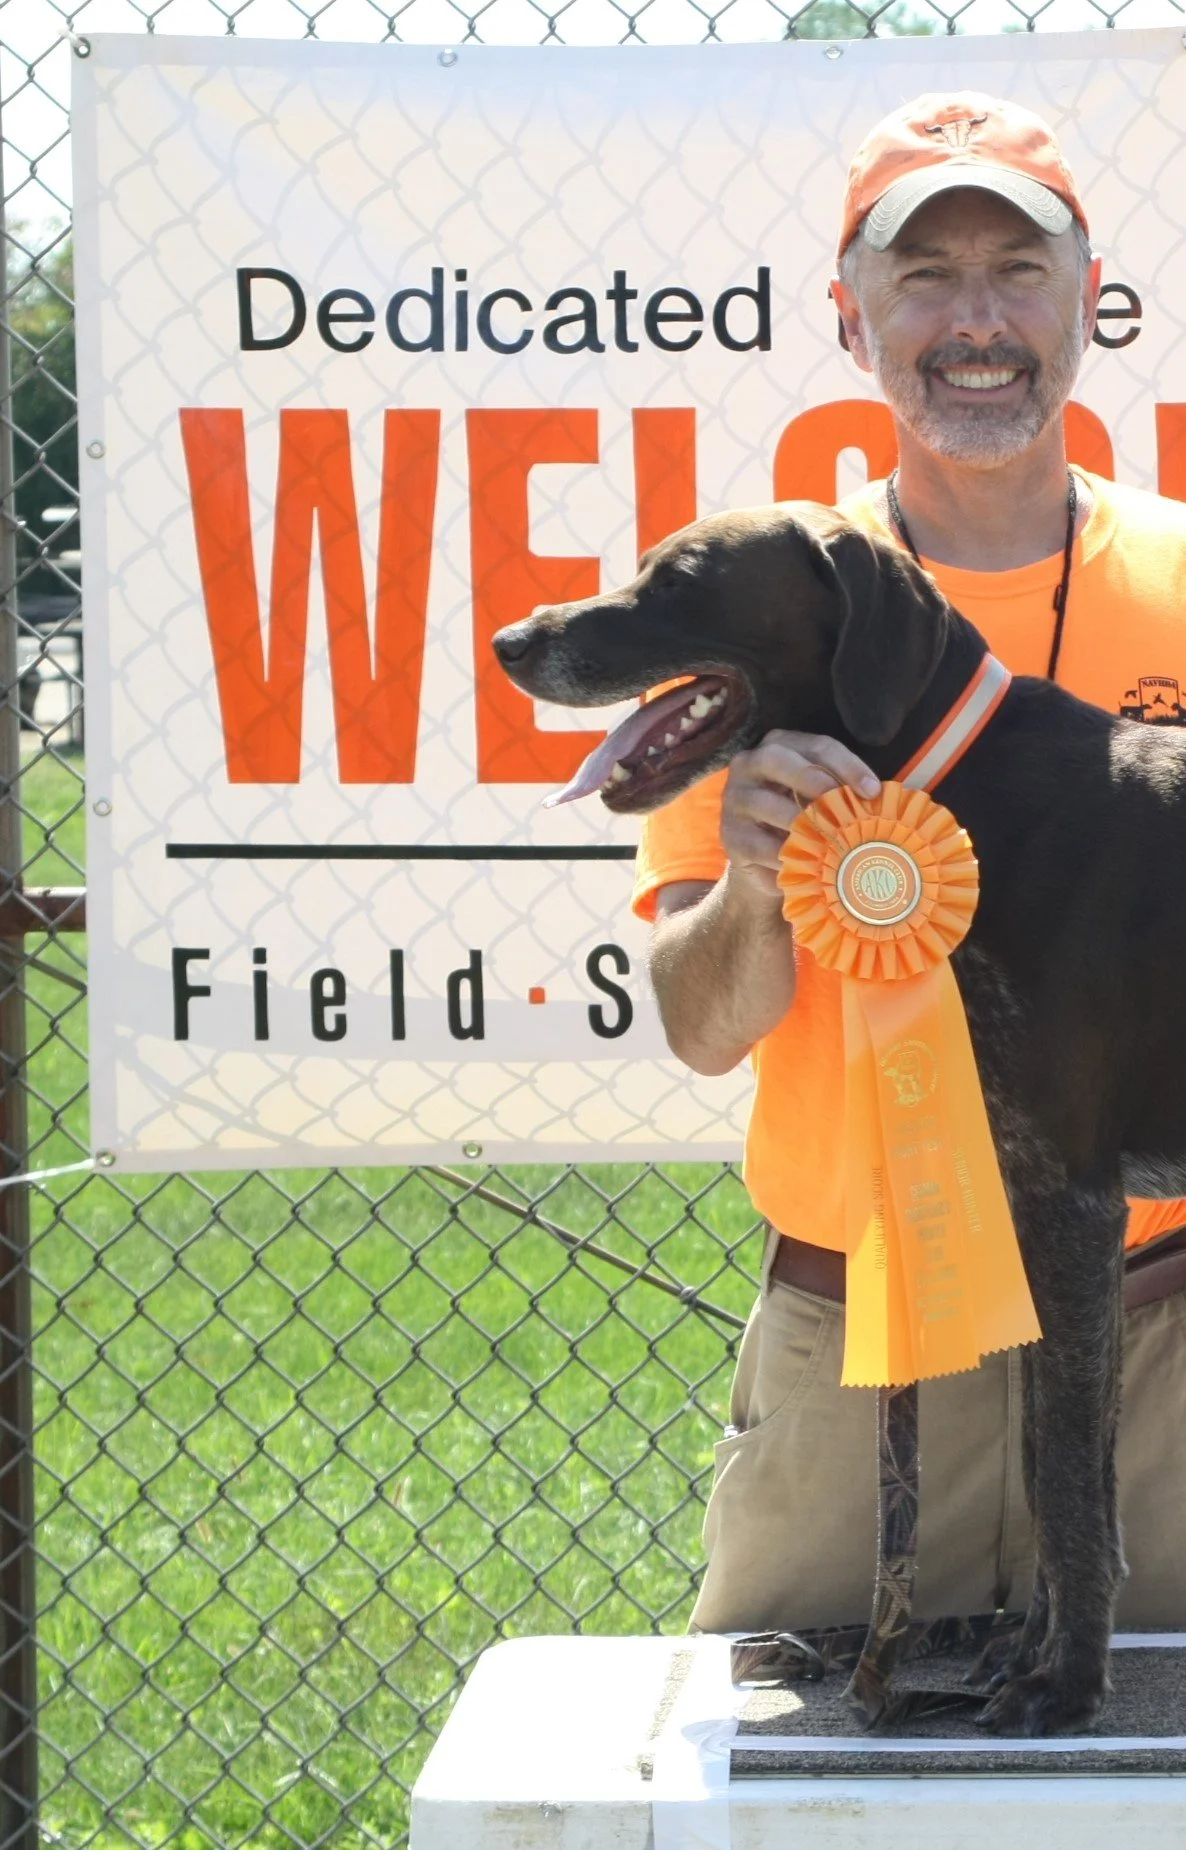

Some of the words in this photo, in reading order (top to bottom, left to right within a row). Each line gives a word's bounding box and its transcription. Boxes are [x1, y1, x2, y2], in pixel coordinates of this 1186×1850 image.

[236, 266, 773, 355] Dedicated
[862, 869, 897, 900] AKC
[171, 946, 486, 1042] Field
[873, 1203, 887, 1270] QUALIFYING
